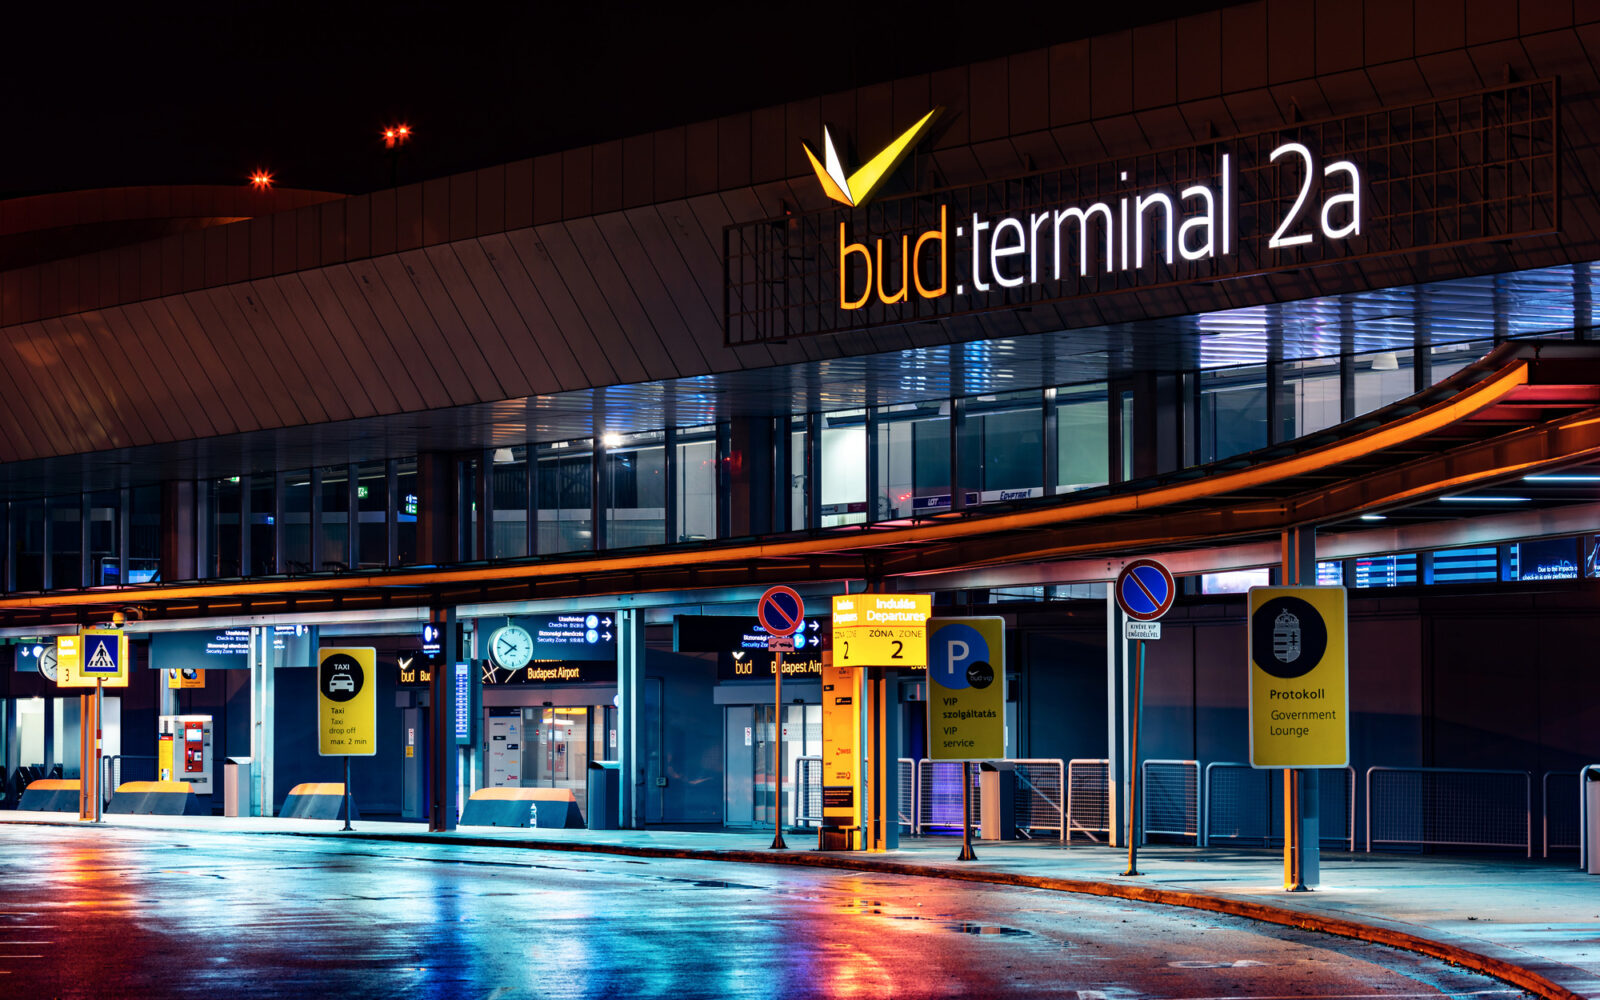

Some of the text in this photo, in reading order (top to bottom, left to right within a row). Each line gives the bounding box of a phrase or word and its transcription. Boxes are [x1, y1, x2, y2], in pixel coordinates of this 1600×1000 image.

[1268, 142, 1360, 248] 2a
[876, 598, 916, 610] Indulás
[866, 610, 926, 624] Departures
[869, 629, 923, 639] ZÓNA ZONE
[844, 641, 849, 660] 2
[891, 640, 903, 659] 2
[948, 640, 970, 674] P
[735, 660, 752, 674] bud
[771, 660, 807, 675] Bdapest
[401, 669, 415, 682] bud
[527, 666, 579, 681] Budapest Airport
[1270, 688, 1325, 700] Protokoll
[943, 697, 958, 706] VIP
[331, 707, 345, 715] Taxi
[942, 709, 997, 720] szolgáltatás
[1270, 710, 1336, 721] Government
[328, 726, 356, 735] drop off
[943, 726, 958, 735] VIP
[1270, 725, 1310, 738] Lounge
[943, 739, 975, 748] service
